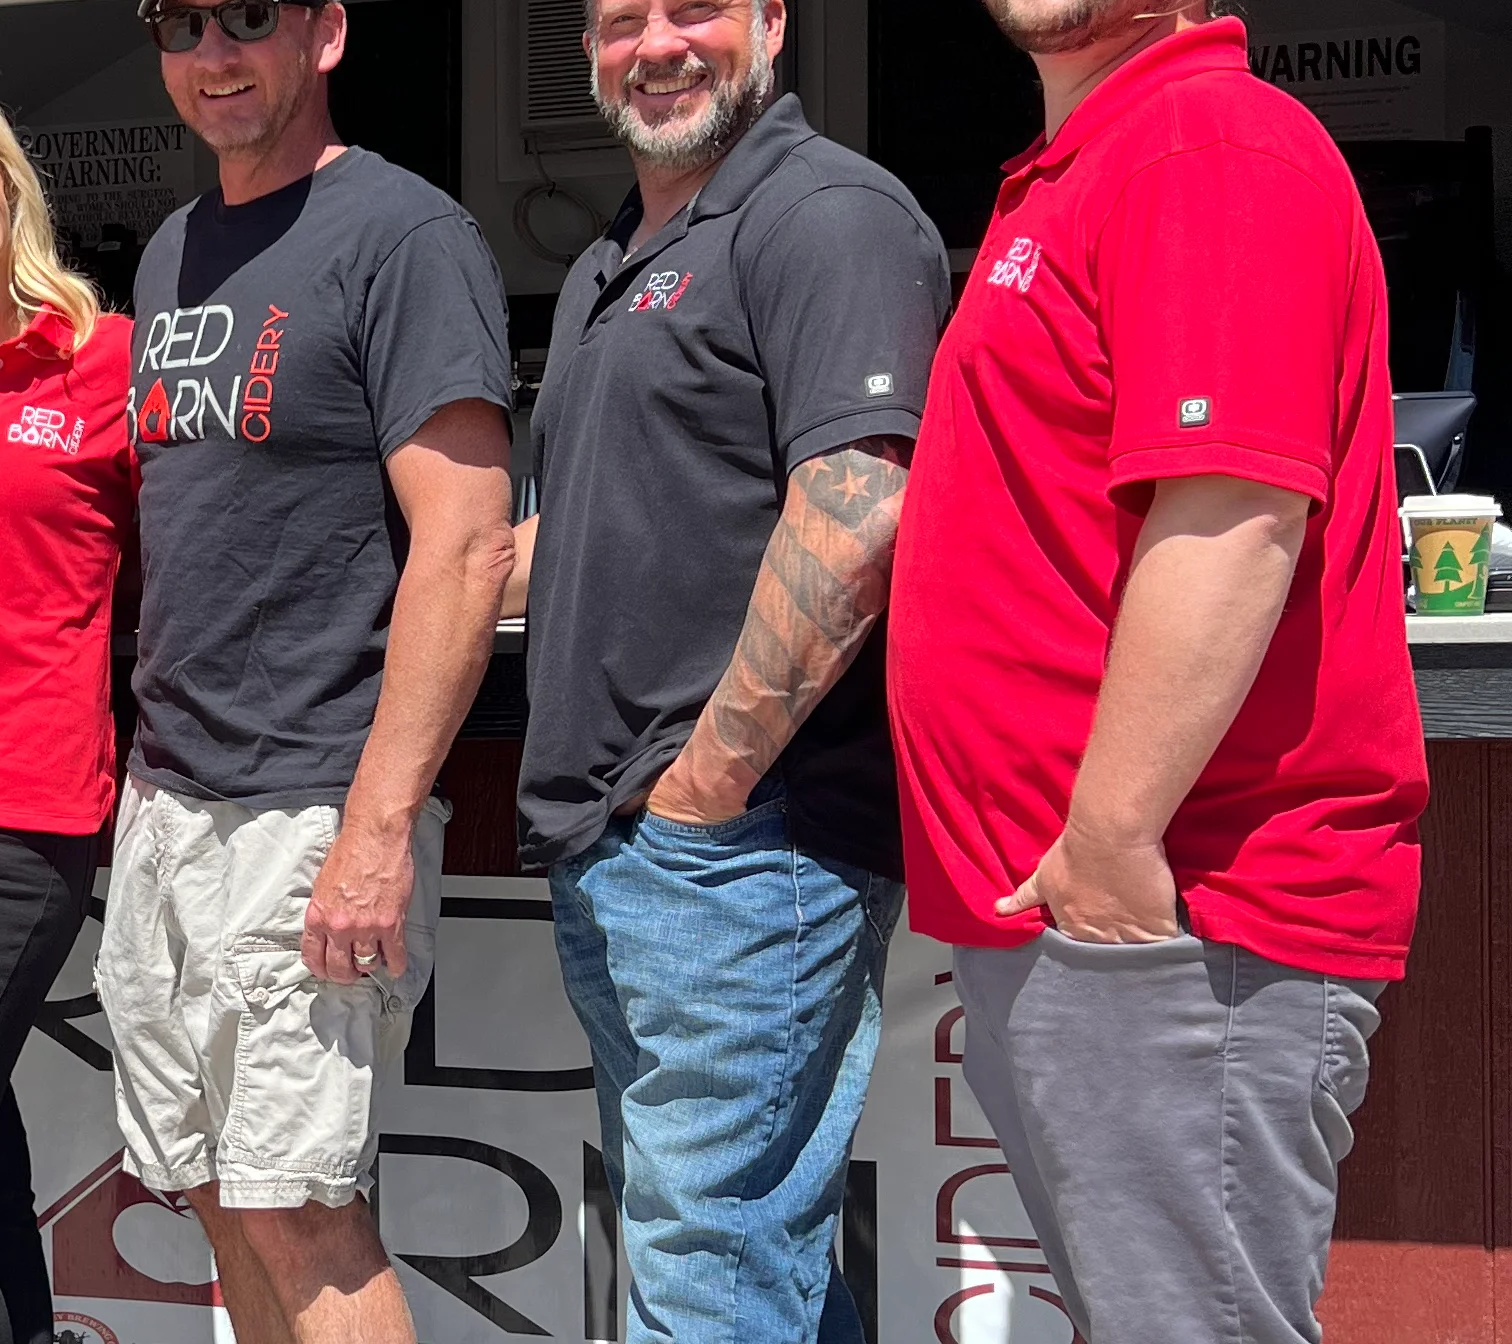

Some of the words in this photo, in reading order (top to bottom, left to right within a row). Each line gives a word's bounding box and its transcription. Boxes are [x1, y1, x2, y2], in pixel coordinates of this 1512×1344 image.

[138, 304, 234, 373] RED
[241, 304, 289, 443] CIDERY
[21, 405, 65, 429] RED
